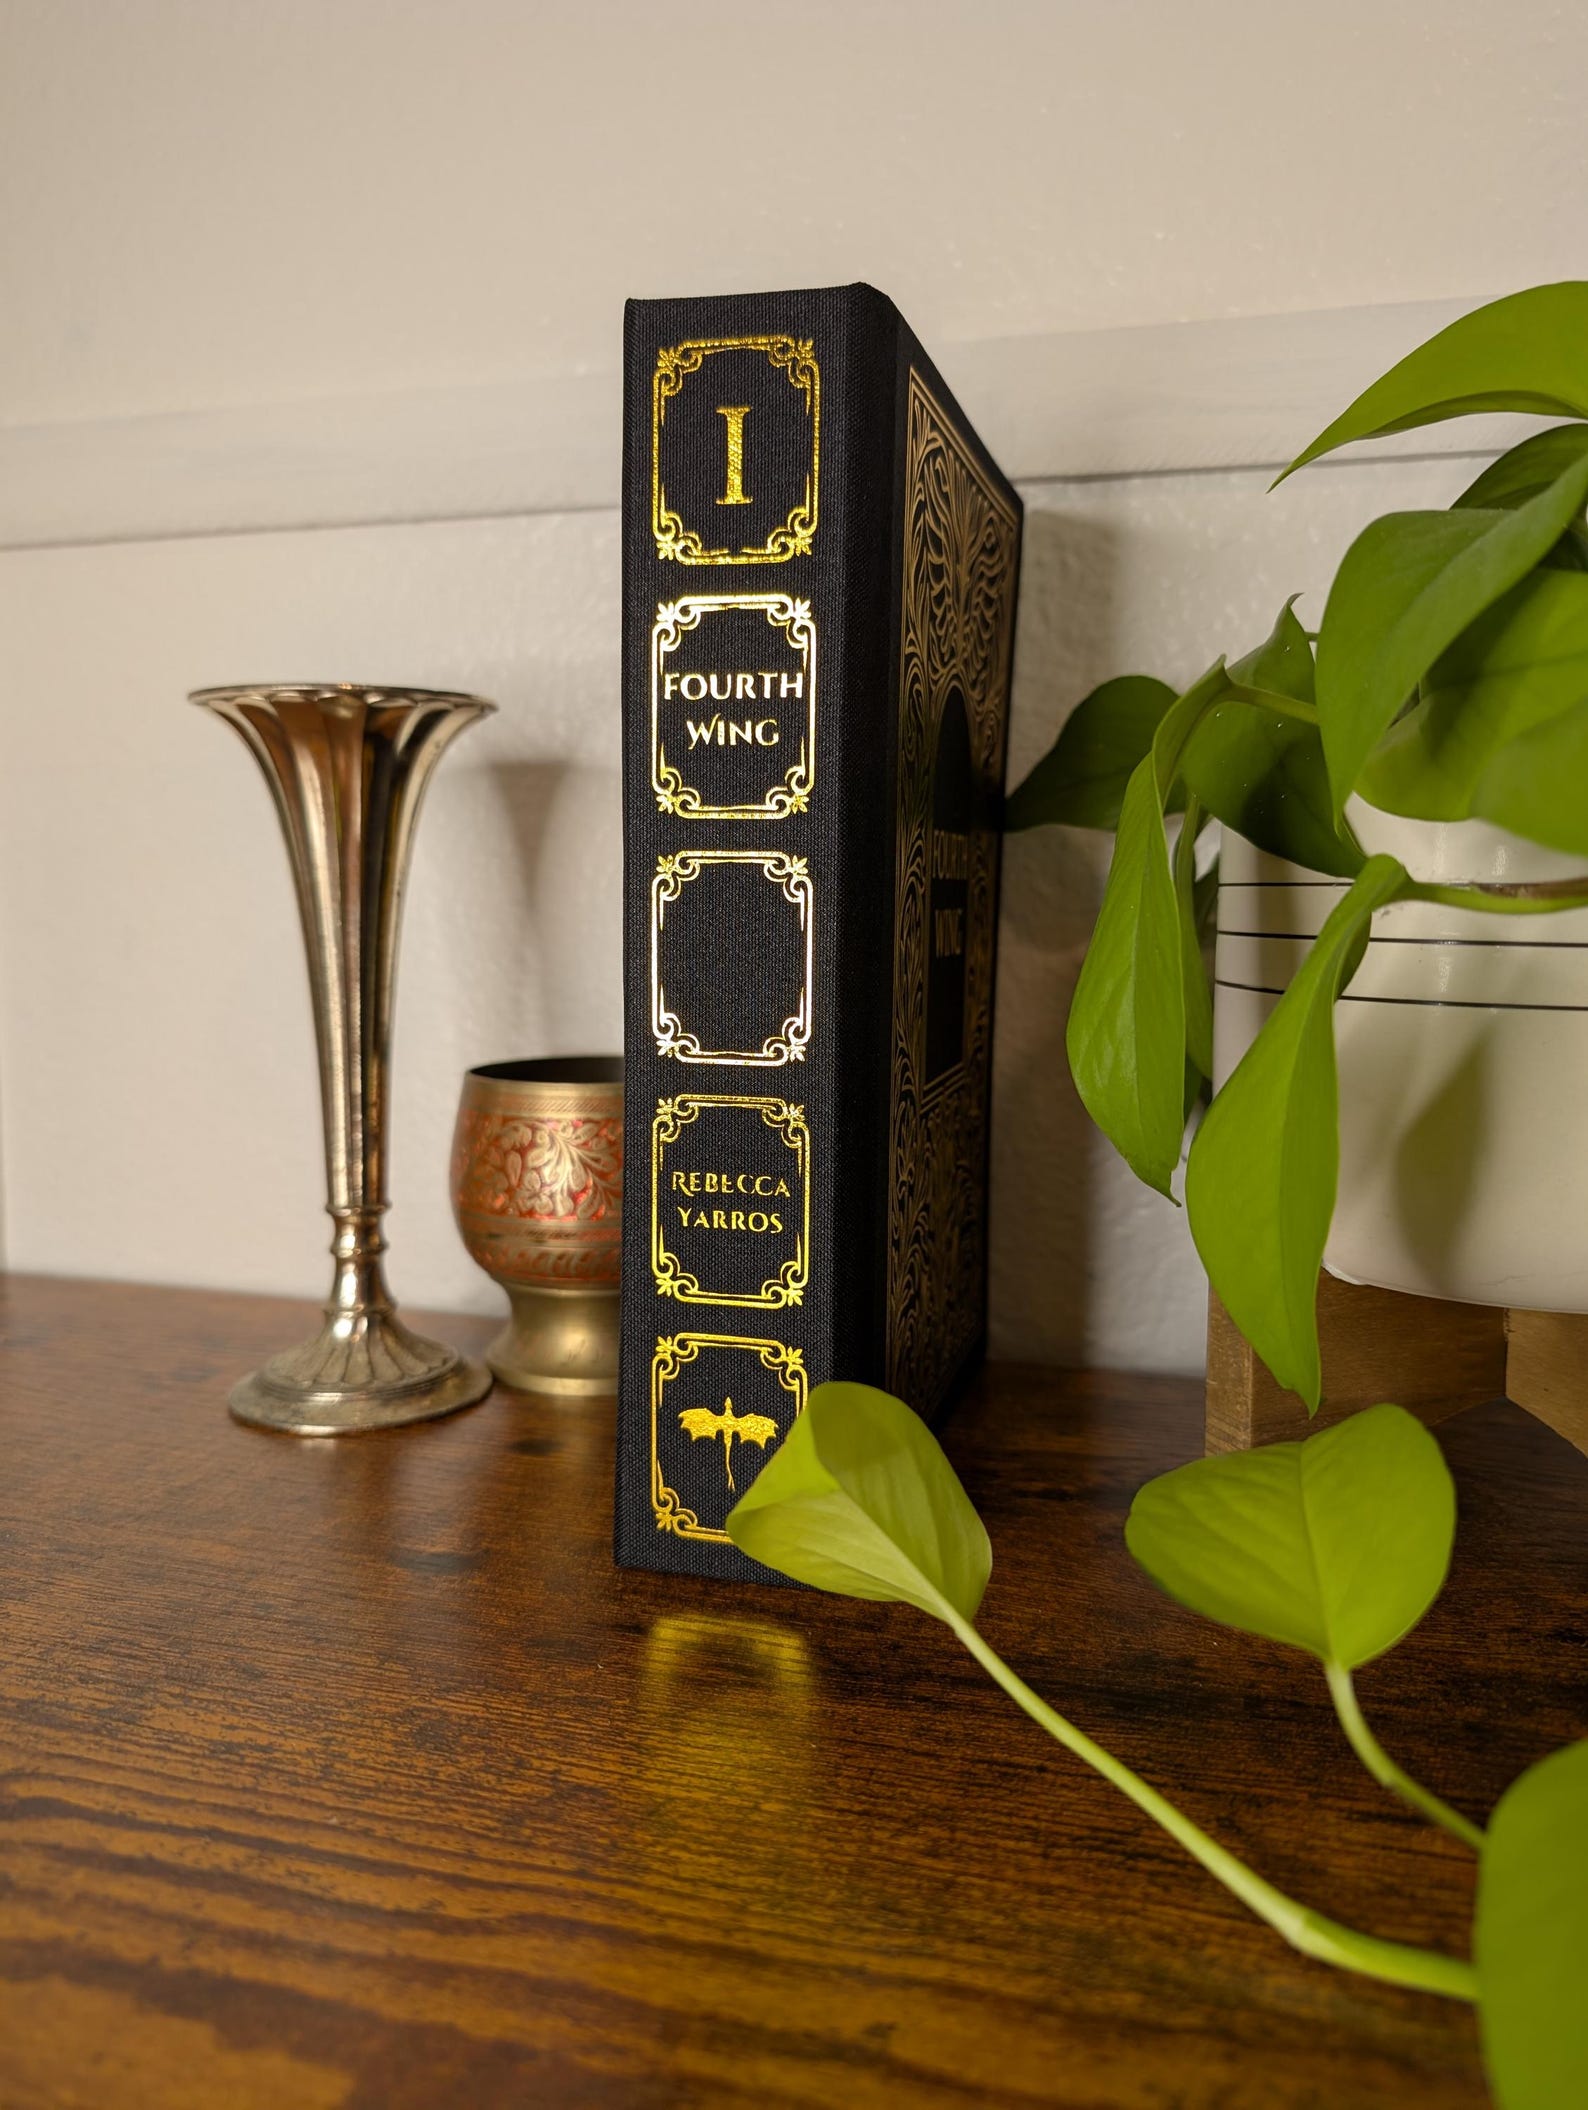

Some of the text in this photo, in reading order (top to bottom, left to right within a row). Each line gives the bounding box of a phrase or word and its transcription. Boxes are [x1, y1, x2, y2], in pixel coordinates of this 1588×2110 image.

[716, 407, 753, 505] I
[664, 672, 803, 700] FOURTH
[686, 713, 779, 750] WING
[672, 1171, 791, 1198] REBECCA
[677, 1206, 784, 1234] YARROS
